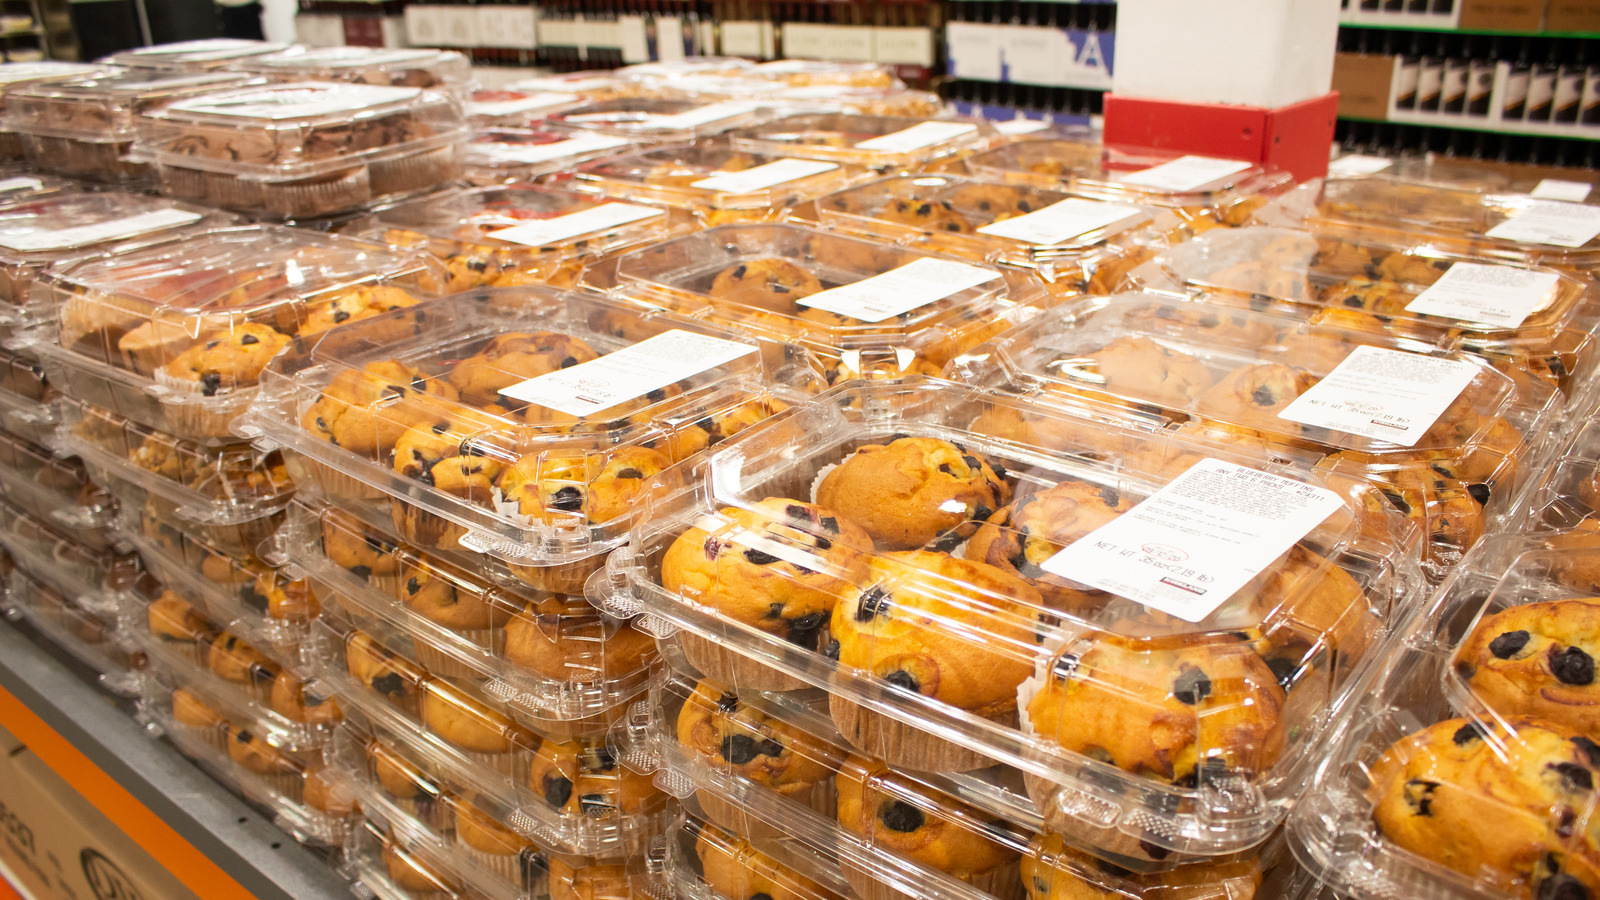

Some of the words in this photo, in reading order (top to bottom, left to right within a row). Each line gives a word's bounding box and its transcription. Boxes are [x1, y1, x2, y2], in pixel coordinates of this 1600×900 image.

[1234, 472, 1249, 481] TWO
[1259, 479, 1284, 490] PACKS
[1236, 467, 1279, 482] BLUEBERRY
[1280, 479, 1315, 493] MUFFINS
[1094, 541, 1117, 552] NET
[1119, 549, 1136, 558] WT
